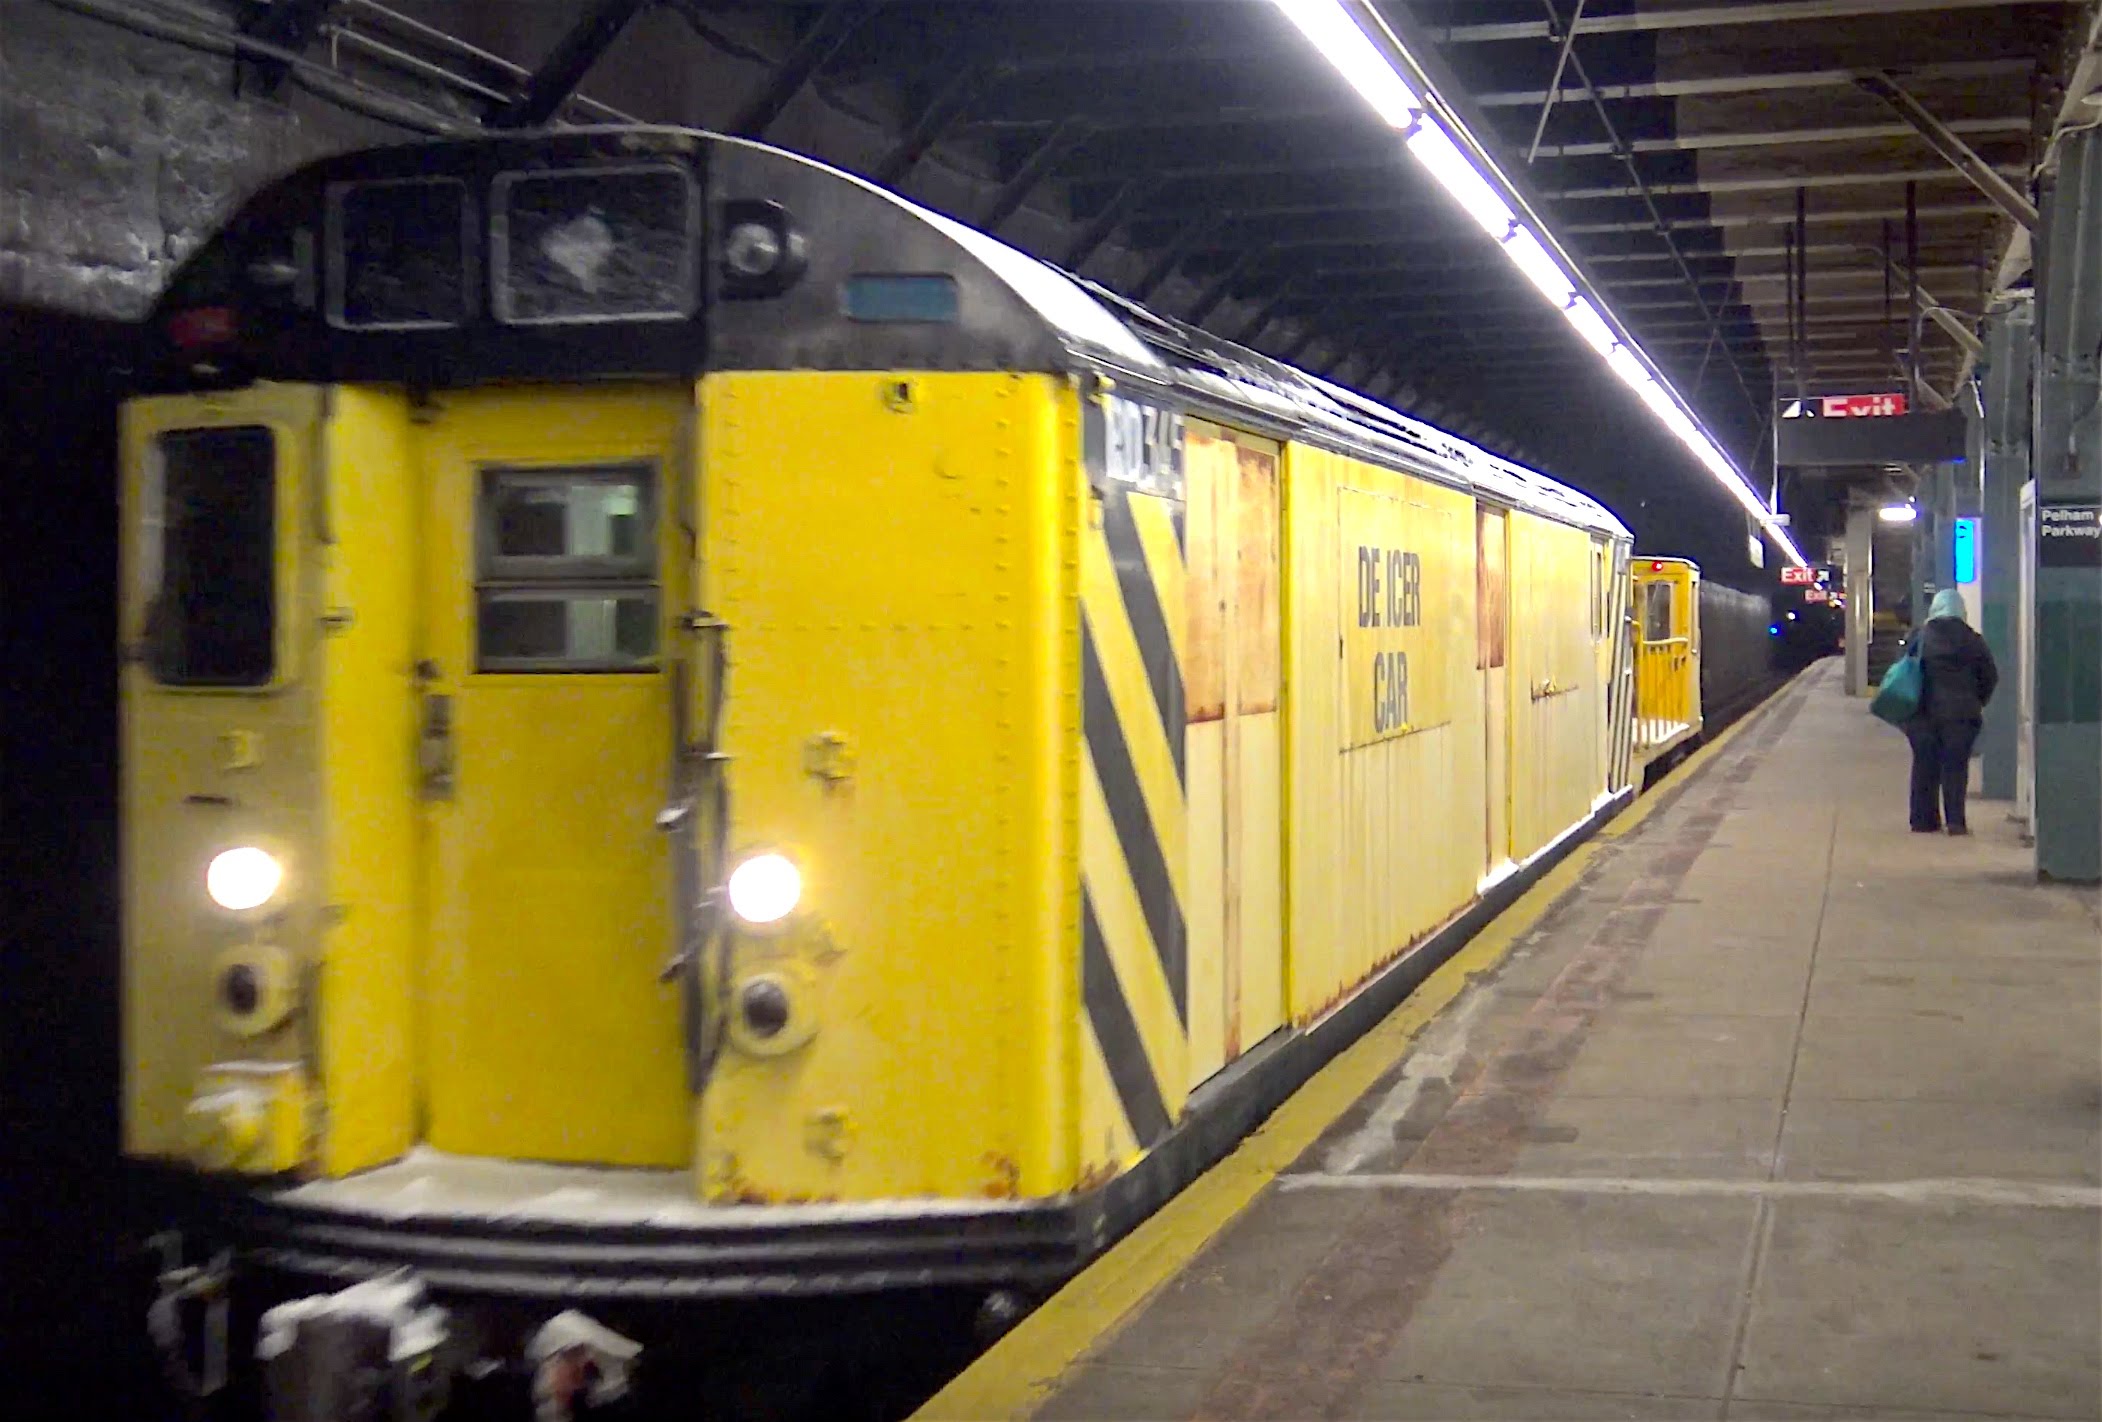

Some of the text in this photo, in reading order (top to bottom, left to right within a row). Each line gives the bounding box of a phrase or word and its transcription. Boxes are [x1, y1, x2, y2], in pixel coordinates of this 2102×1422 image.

[2041, 510, 2095, 521] Pelham
[2041, 525, 2101, 539] Parkway
[1781, 567, 1815, 582] Exit
[1374, 651, 1408, 733] CAR
